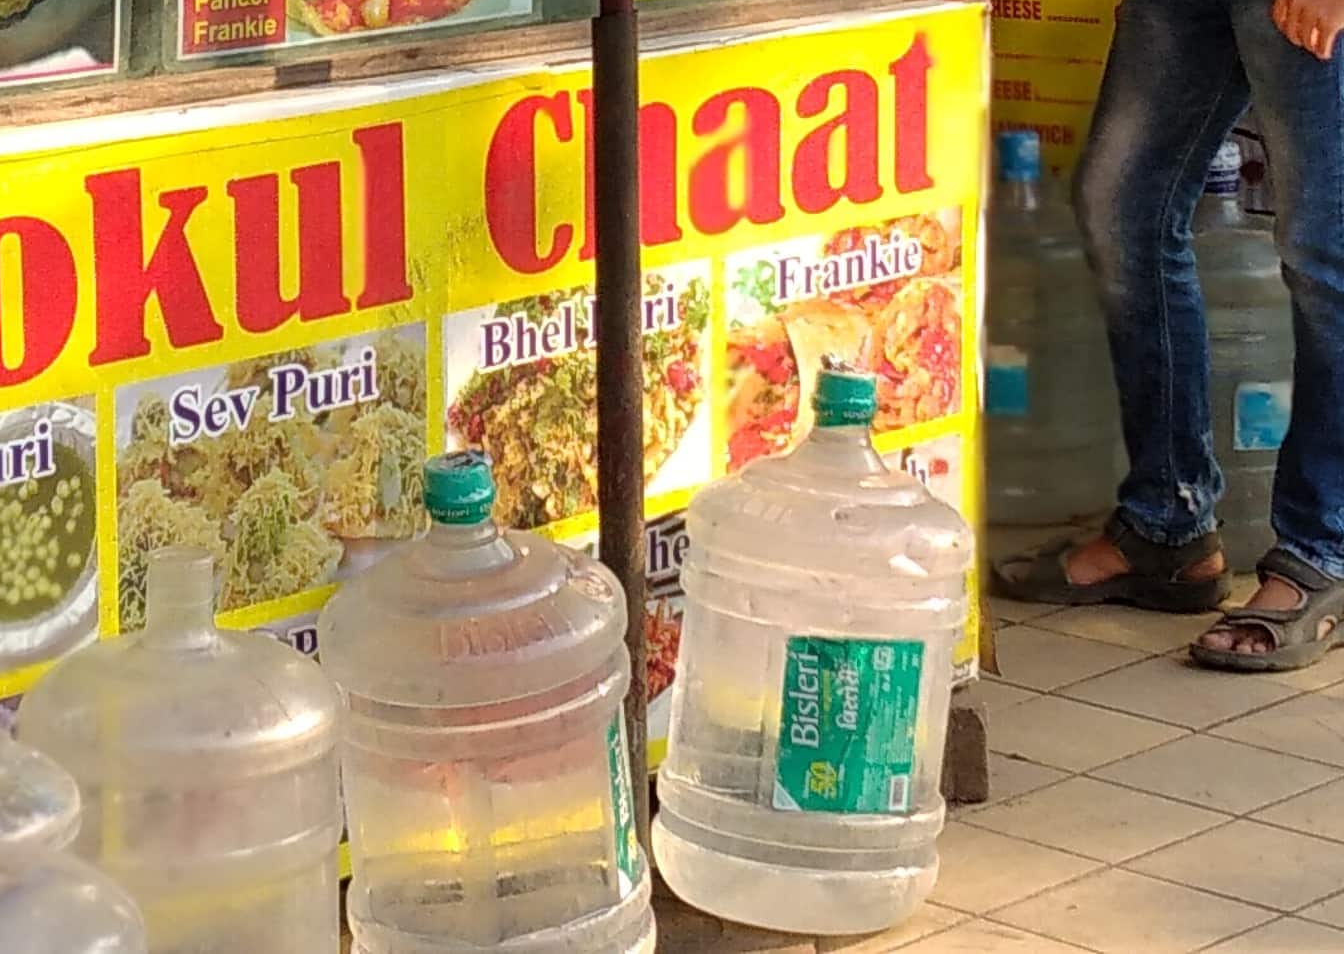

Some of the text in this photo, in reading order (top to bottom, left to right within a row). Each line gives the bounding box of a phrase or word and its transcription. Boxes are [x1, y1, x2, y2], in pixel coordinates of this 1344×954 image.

[194, 15, 277, 44] Frankie
[778, 236, 922, 301] Frankie
[482, 311, 574, 368] Bhel
[173, 351, 376, 441] Sev Puri
[789, 652, 821, 748] Bisleri
